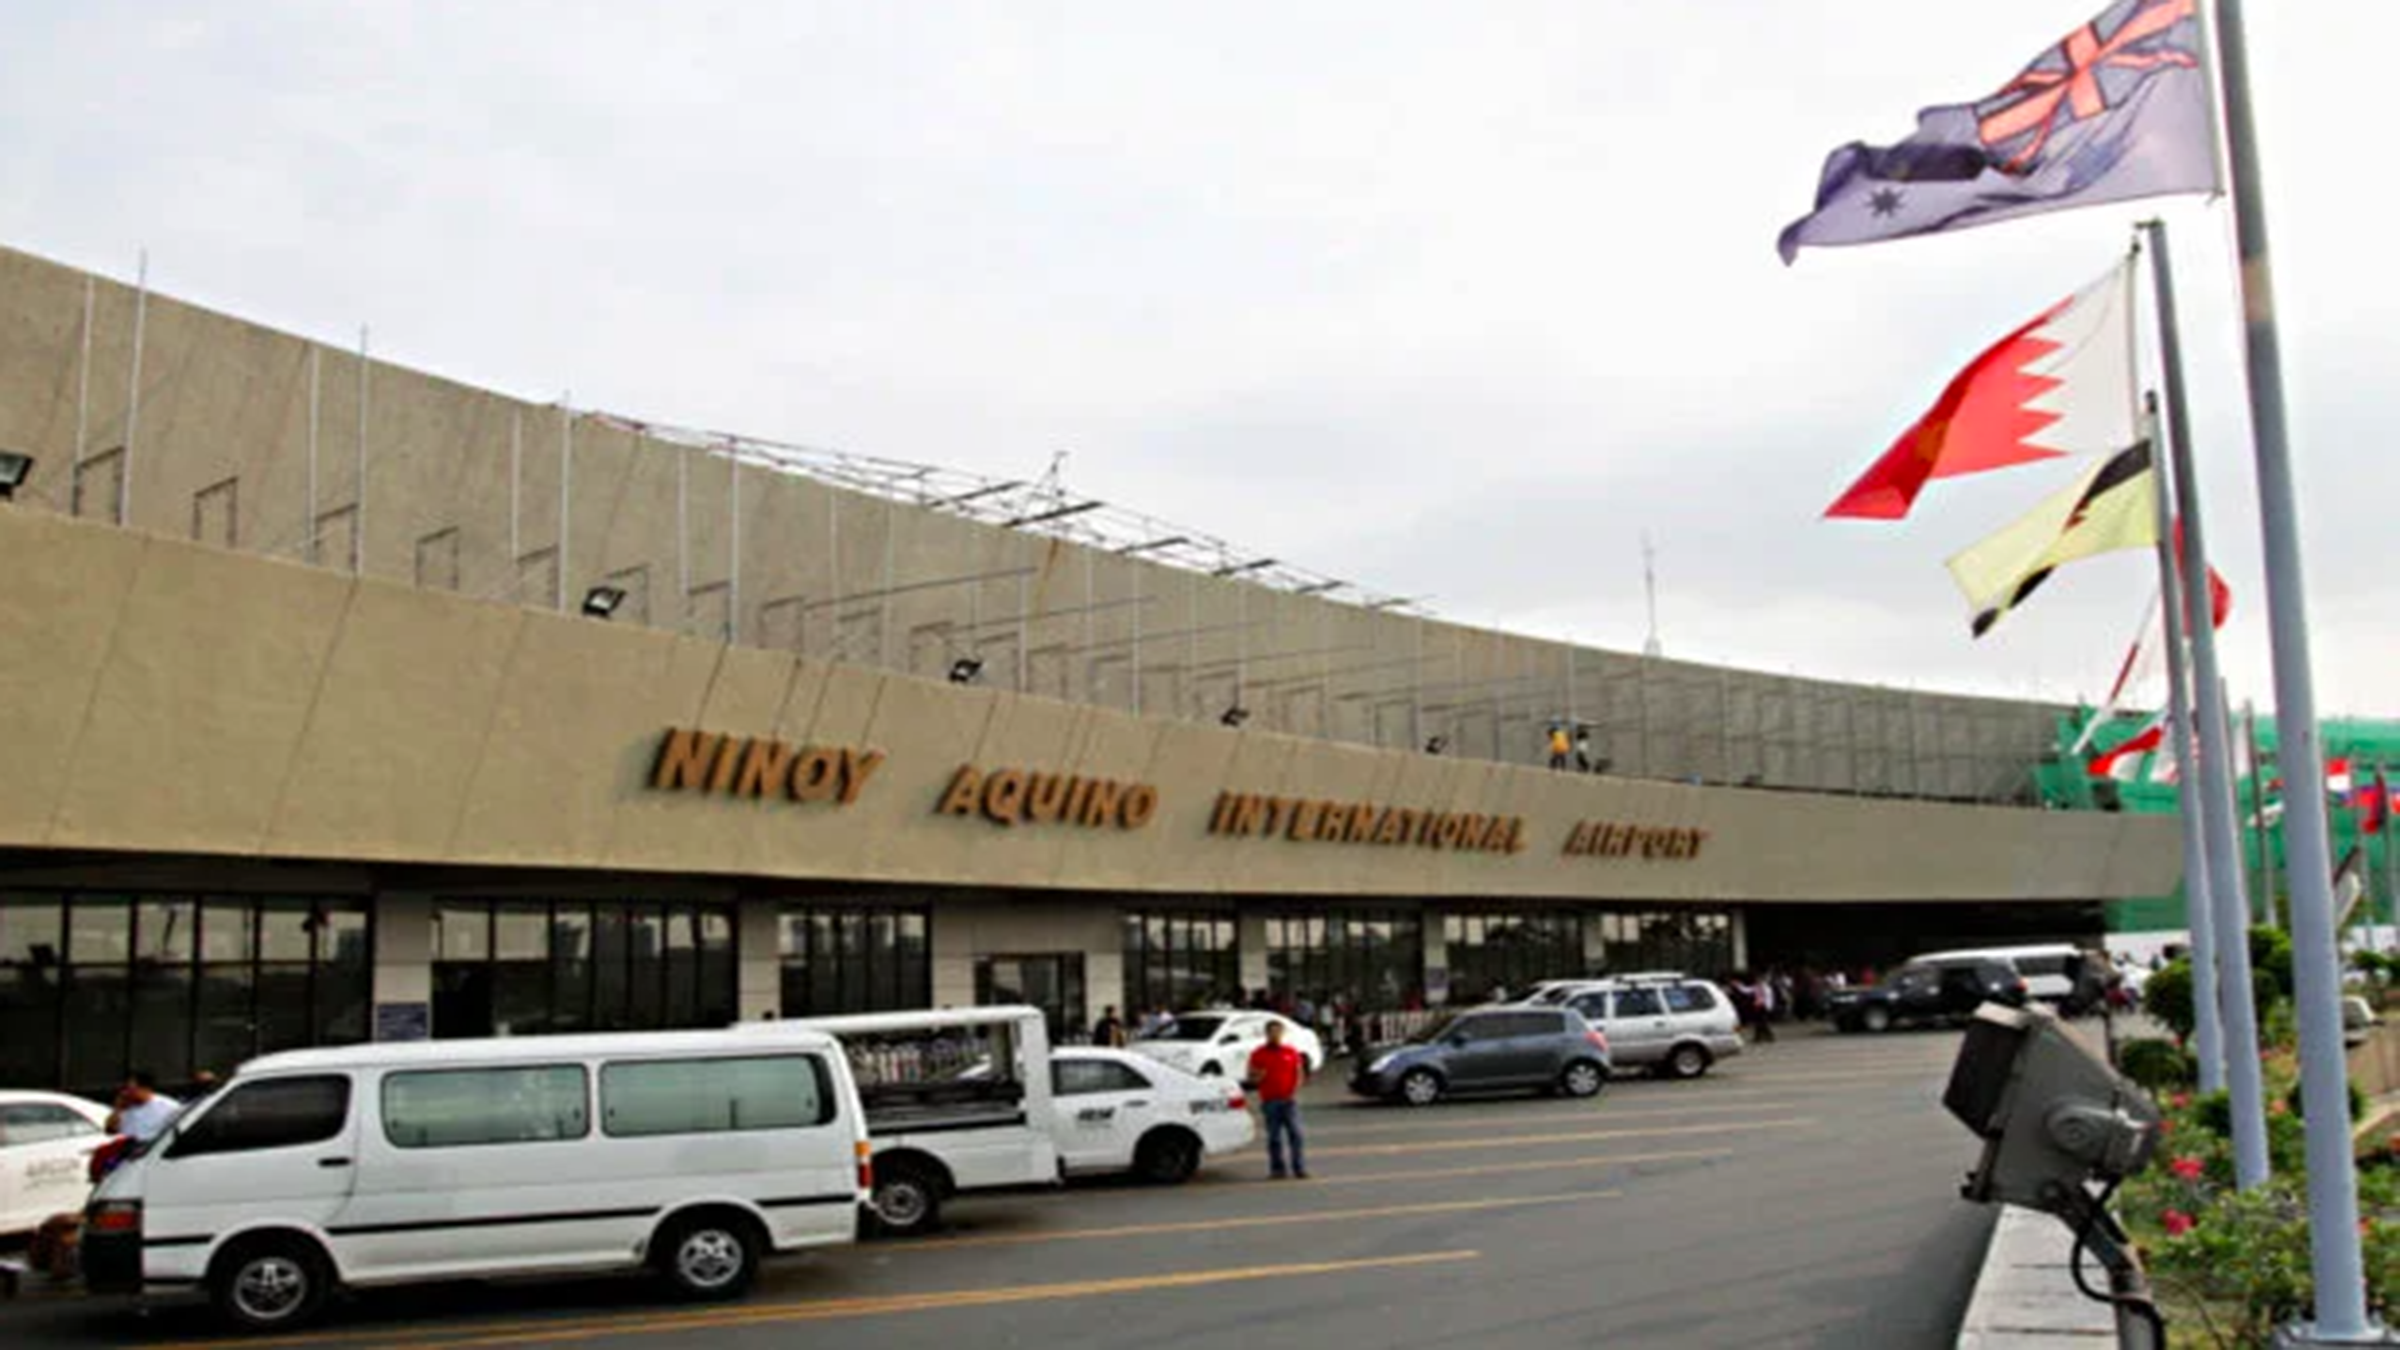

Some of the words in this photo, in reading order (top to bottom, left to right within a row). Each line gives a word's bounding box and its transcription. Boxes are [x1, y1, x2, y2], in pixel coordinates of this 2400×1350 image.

[647, 726, 885, 805] NINOY
[934, 763, 1160, 829] AQUINO
[1208, 790, 1528, 855] INTERNATIONAL
[1562, 820, 1709, 860] AIRPORT
